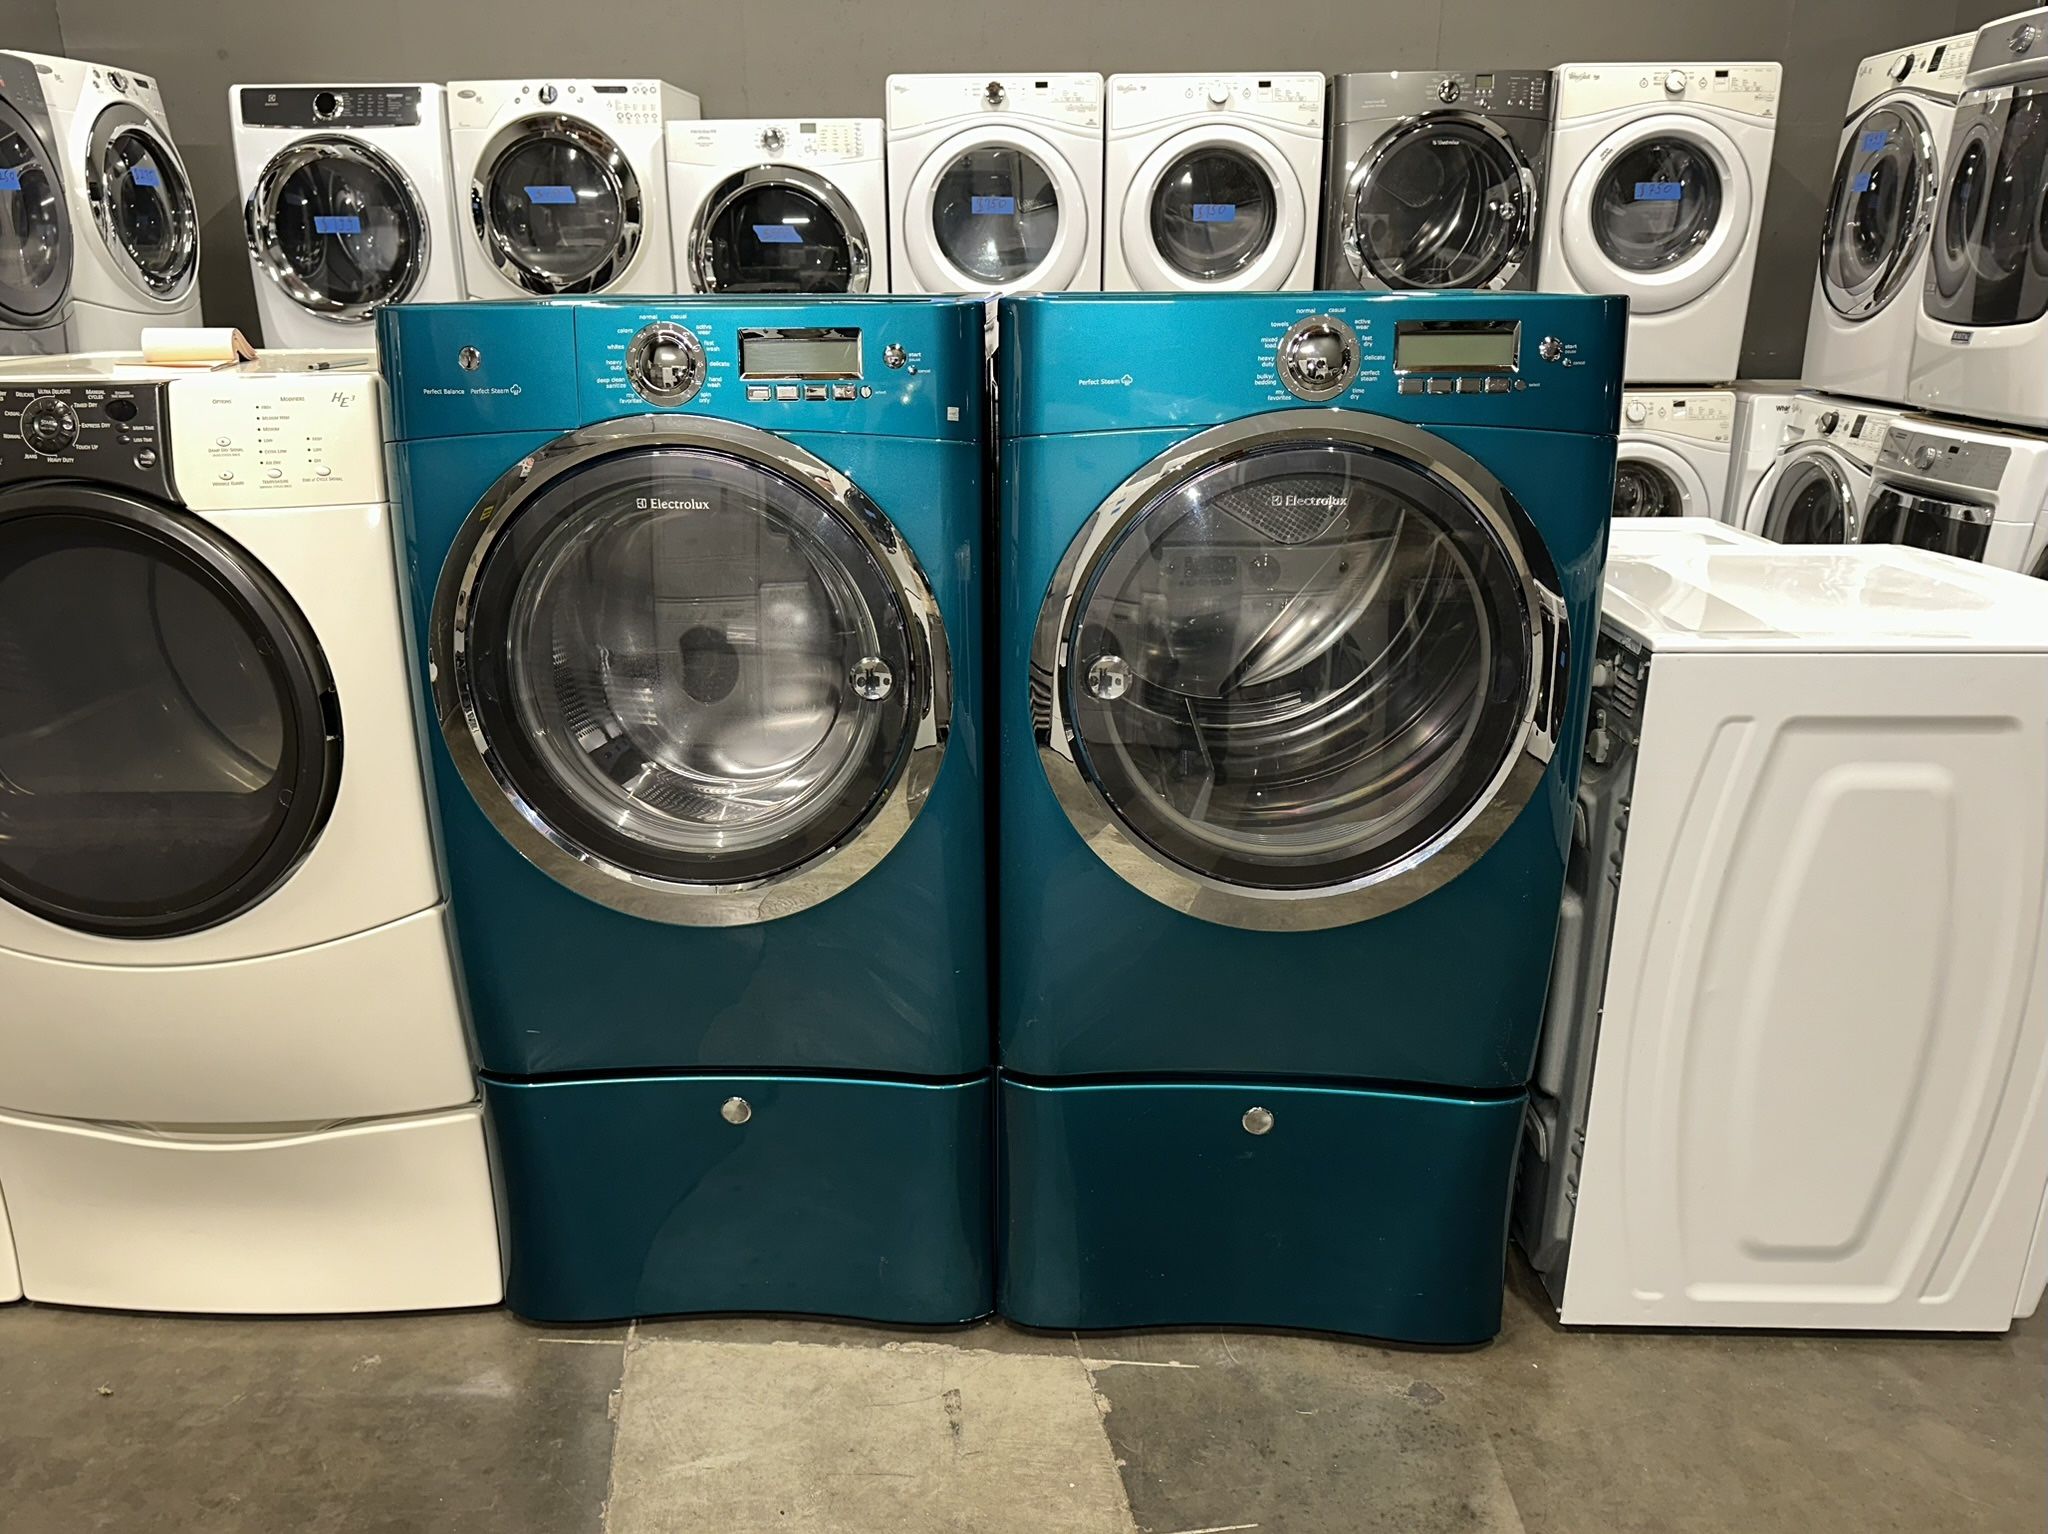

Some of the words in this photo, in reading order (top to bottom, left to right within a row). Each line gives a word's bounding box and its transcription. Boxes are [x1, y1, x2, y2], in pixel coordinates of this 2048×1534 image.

[1264, 341, 1277, 349] load
[1257, 355, 1275, 363] heavy
[1261, 360, 1275, 368] duty
[1078, 378, 1099, 386] Perfect
[1254, 378, 1277, 386] bedding
[650, 497, 710, 510] Electrolux
[1285, 494, 1348, 507] Electrolux
